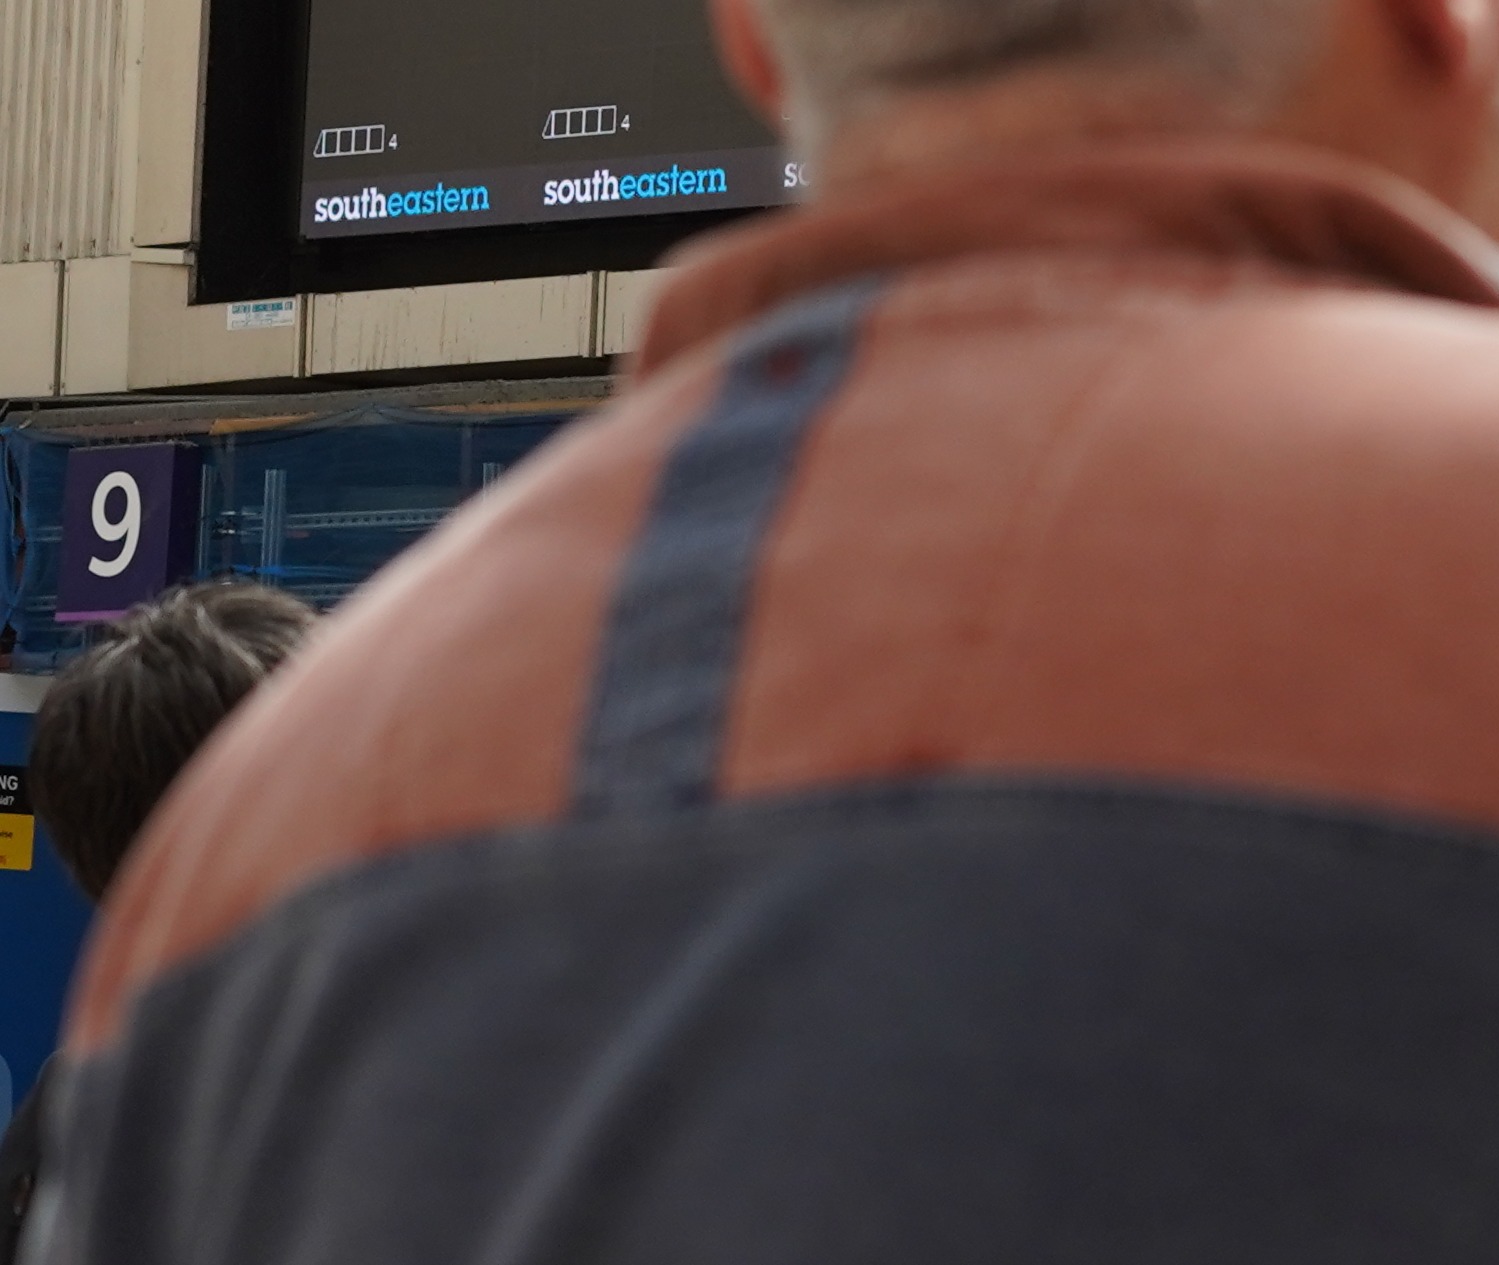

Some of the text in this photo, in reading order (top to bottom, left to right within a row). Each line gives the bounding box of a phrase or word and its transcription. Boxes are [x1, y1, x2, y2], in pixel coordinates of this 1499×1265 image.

[314, 182, 490, 222] southeastern
[543, 164, 727, 206] southeastern
[88, 471, 142, 577] 9
